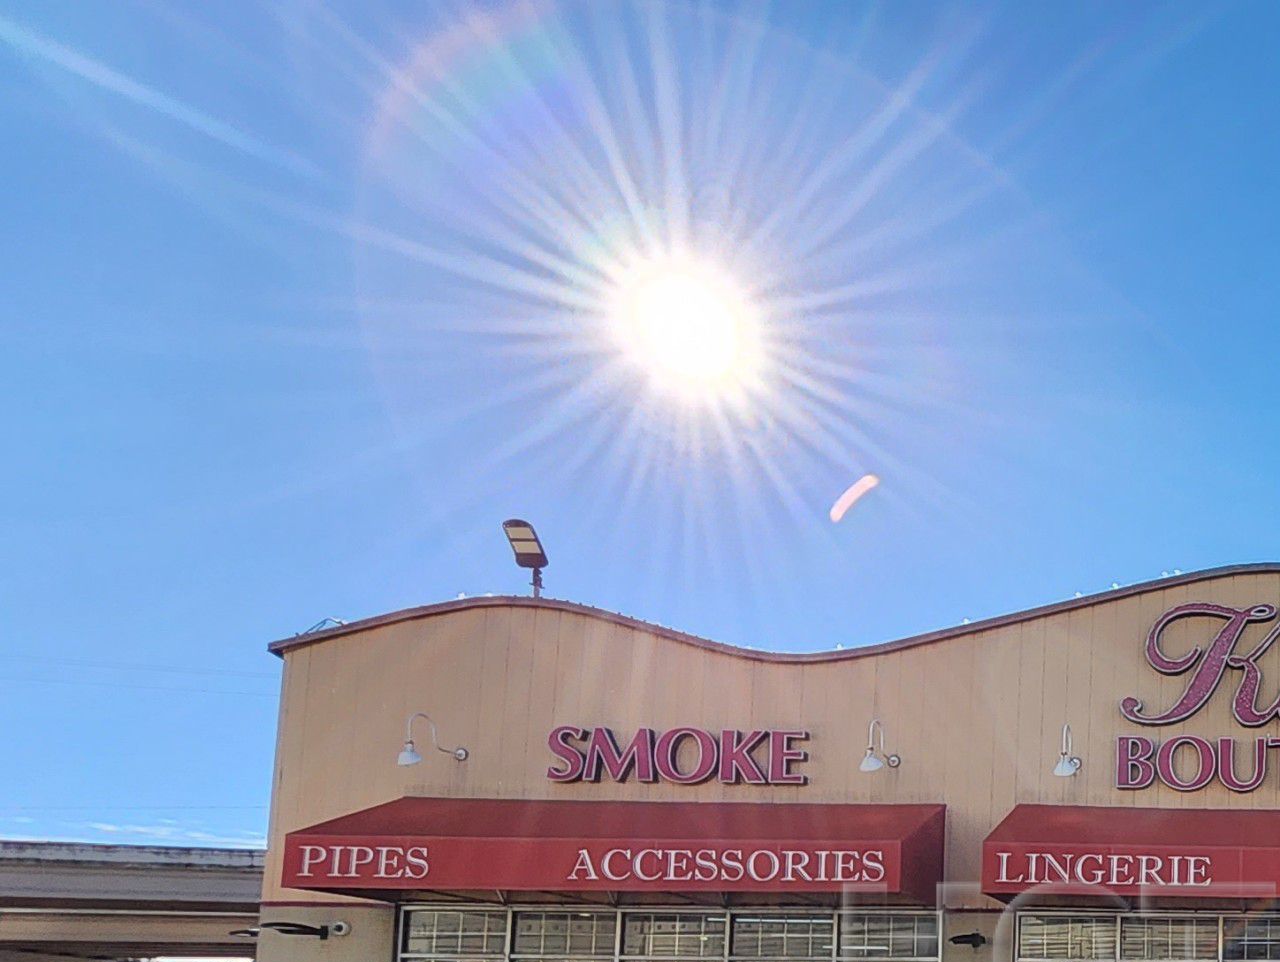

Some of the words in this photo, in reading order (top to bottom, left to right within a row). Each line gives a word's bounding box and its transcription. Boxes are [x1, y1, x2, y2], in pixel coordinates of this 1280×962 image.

[546, 725, 810, 786] SMOKE
[296, 845, 430, 879] PIPES
[566, 847, 887, 883] ACCESSORIES
[995, 852, 1213, 888] LINGERIE
